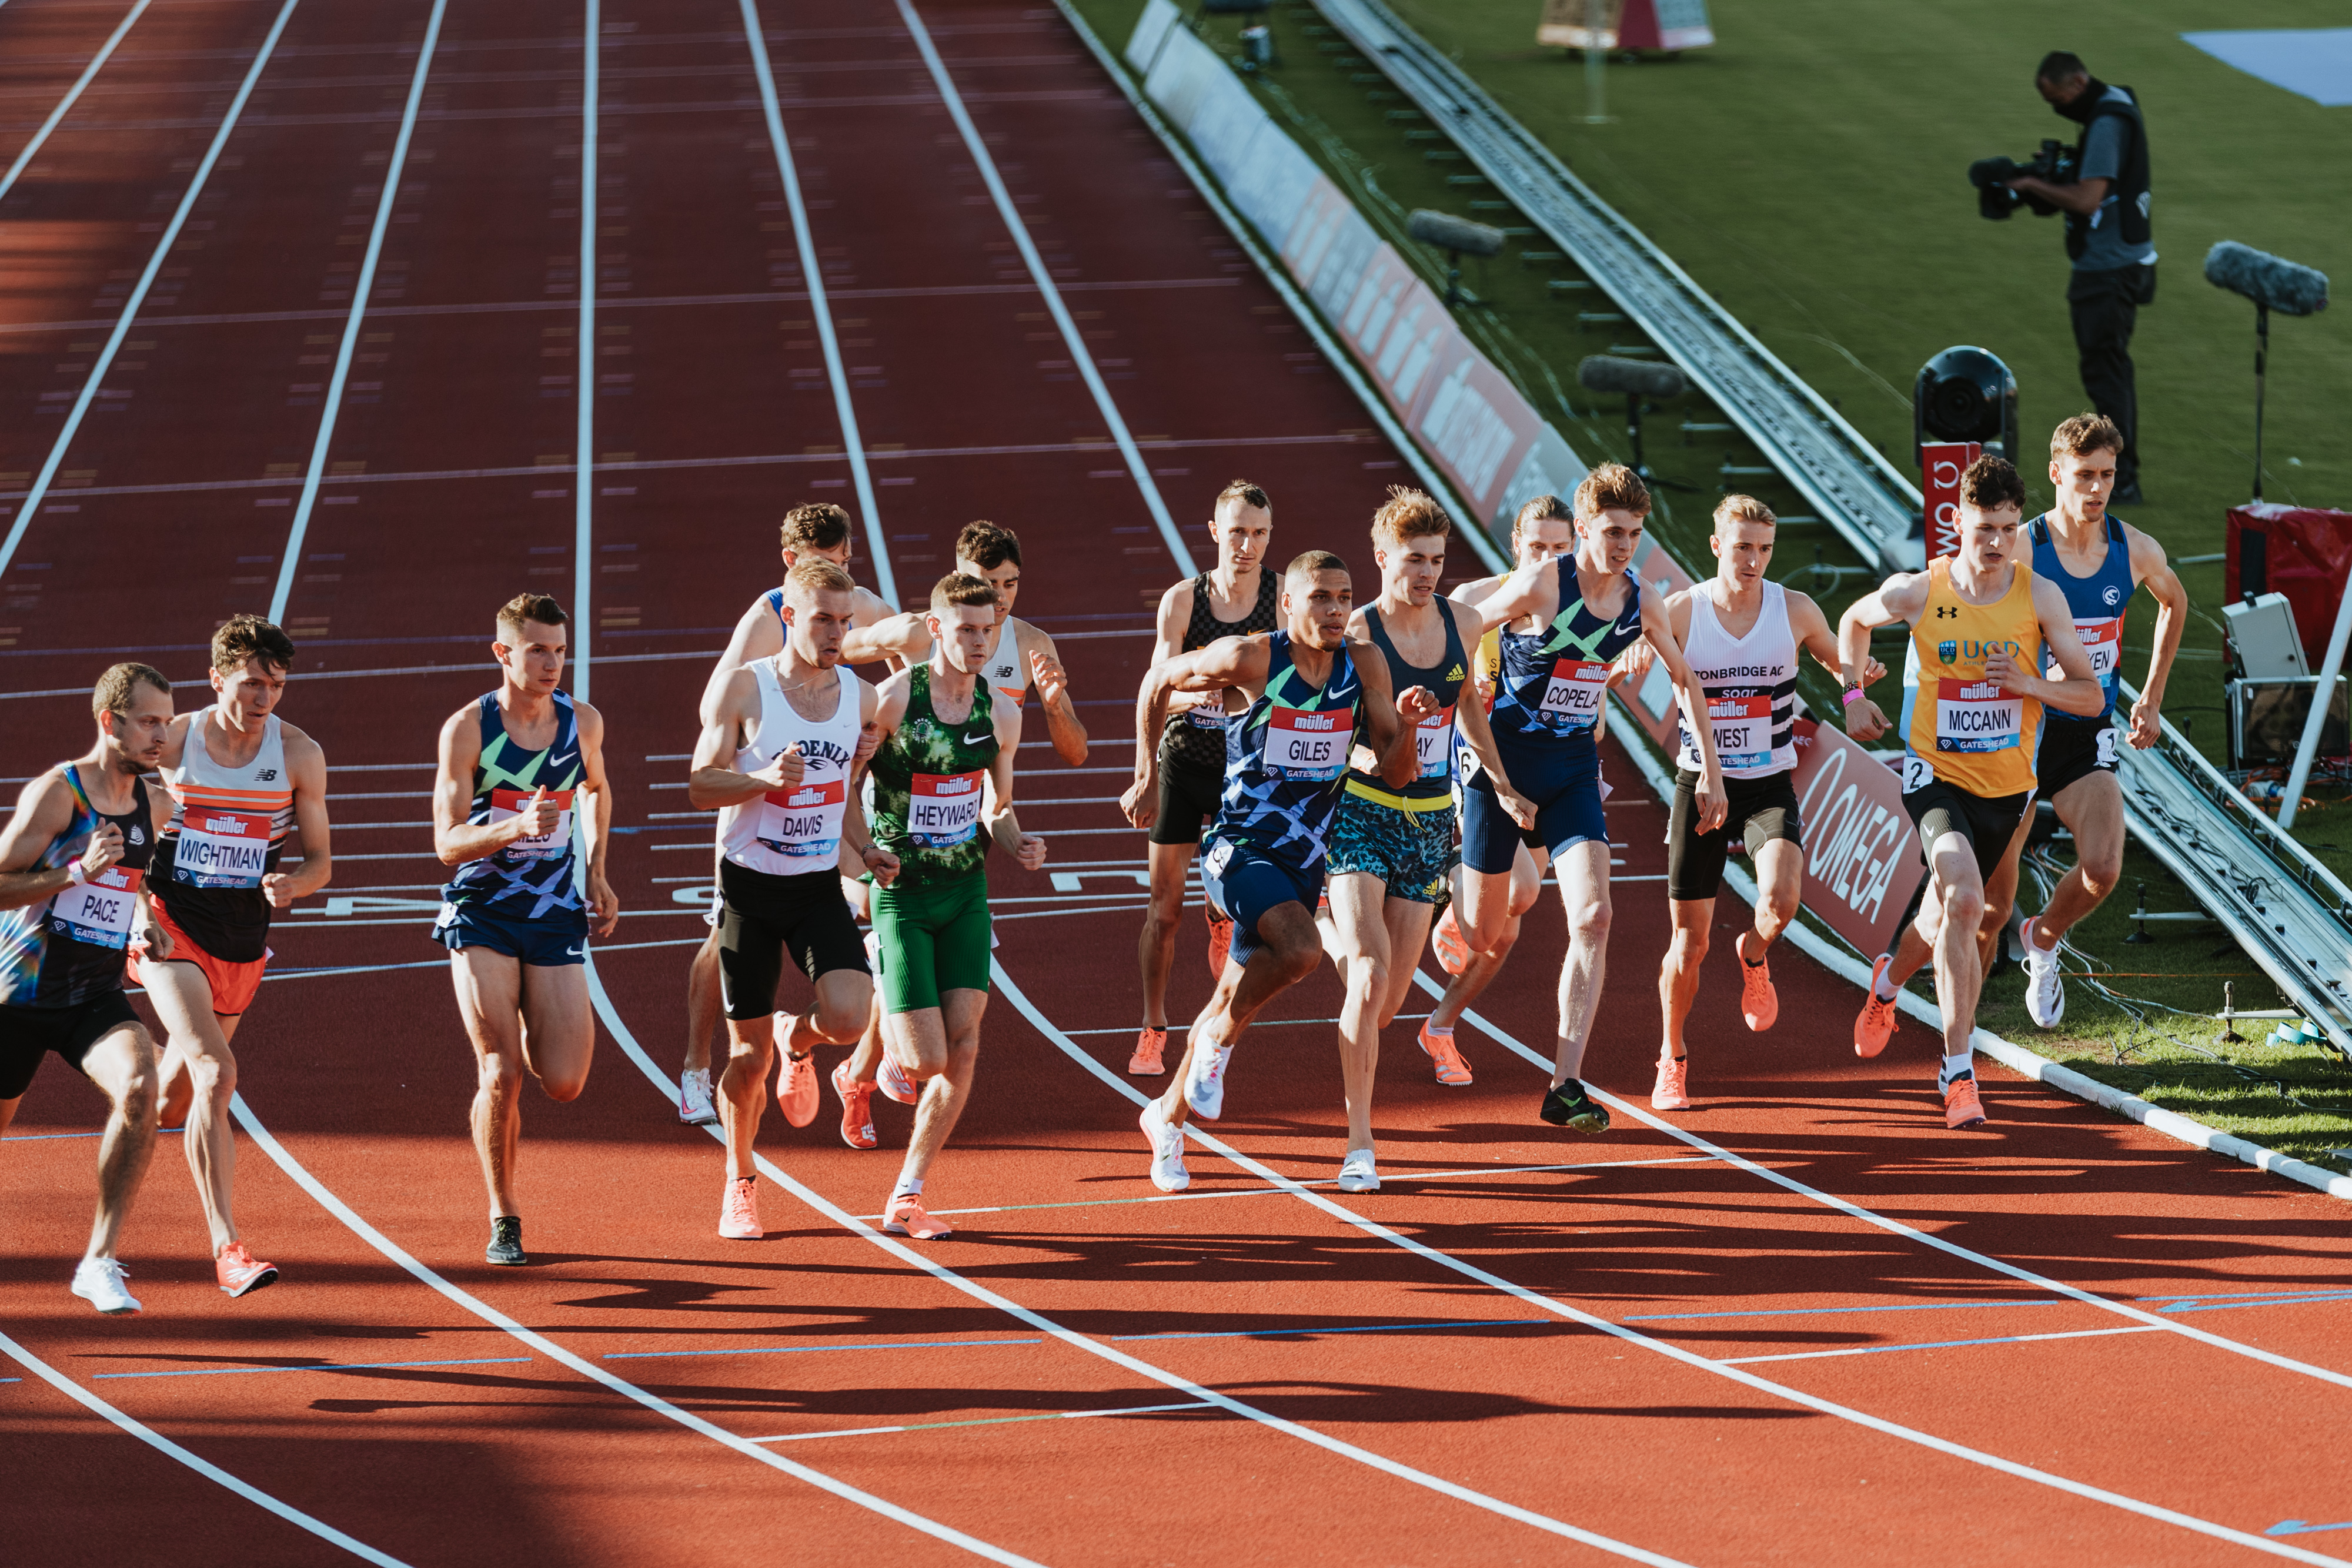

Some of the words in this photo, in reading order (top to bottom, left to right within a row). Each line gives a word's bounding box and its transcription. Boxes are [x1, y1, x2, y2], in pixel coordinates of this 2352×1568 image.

[2076, 628, 2102, 643] üller
[1446, 674, 1465, 682] adidas
[1693, 666, 1768, 681] TONBRIDGE
[1769, 665, 1784, 677] AC
[1722, 688, 1758, 698] soar
[1960, 681, 2001, 700] müller
[1708, 700, 1749, 717] müller
[1294, 714, 1335, 730] müller
[1949, 708, 2011, 732] MCCANN
[1713, 727, 1750, 748] WEST
[1960, 738, 2009, 749] GATESHEAD
[771, 740, 850, 770] OENIX
[1289, 740, 1331, 761] GILES
[1718, 755, 1760, 765] ATESHEAD
[1287, 769, 1335, 778] GATESHEAD
[1909, 761, 1923, 790] 2
[936, 777, 973, 794] müller
[788, 787, 826, 807] müller
[915, 798, 977, 827] HEYWARD
[205, 815, 249, 834] müller
[783, 814, 823, 837] DAVIS
[931, 828, 972, 844] GATESHEAD
[181, 837, 263, 870] WIGHTMAN
[507, 851, 556, 859] GATESHEAD
[780, 842, 831, 854] GATESHEAD
[1809, 784, 1913, 924] OMEGA
[196, 875, 248, 885] GATESHEAD
[81, 894, 121, 924] PACE
[74, 927, 120, 944] GATESHEAD
